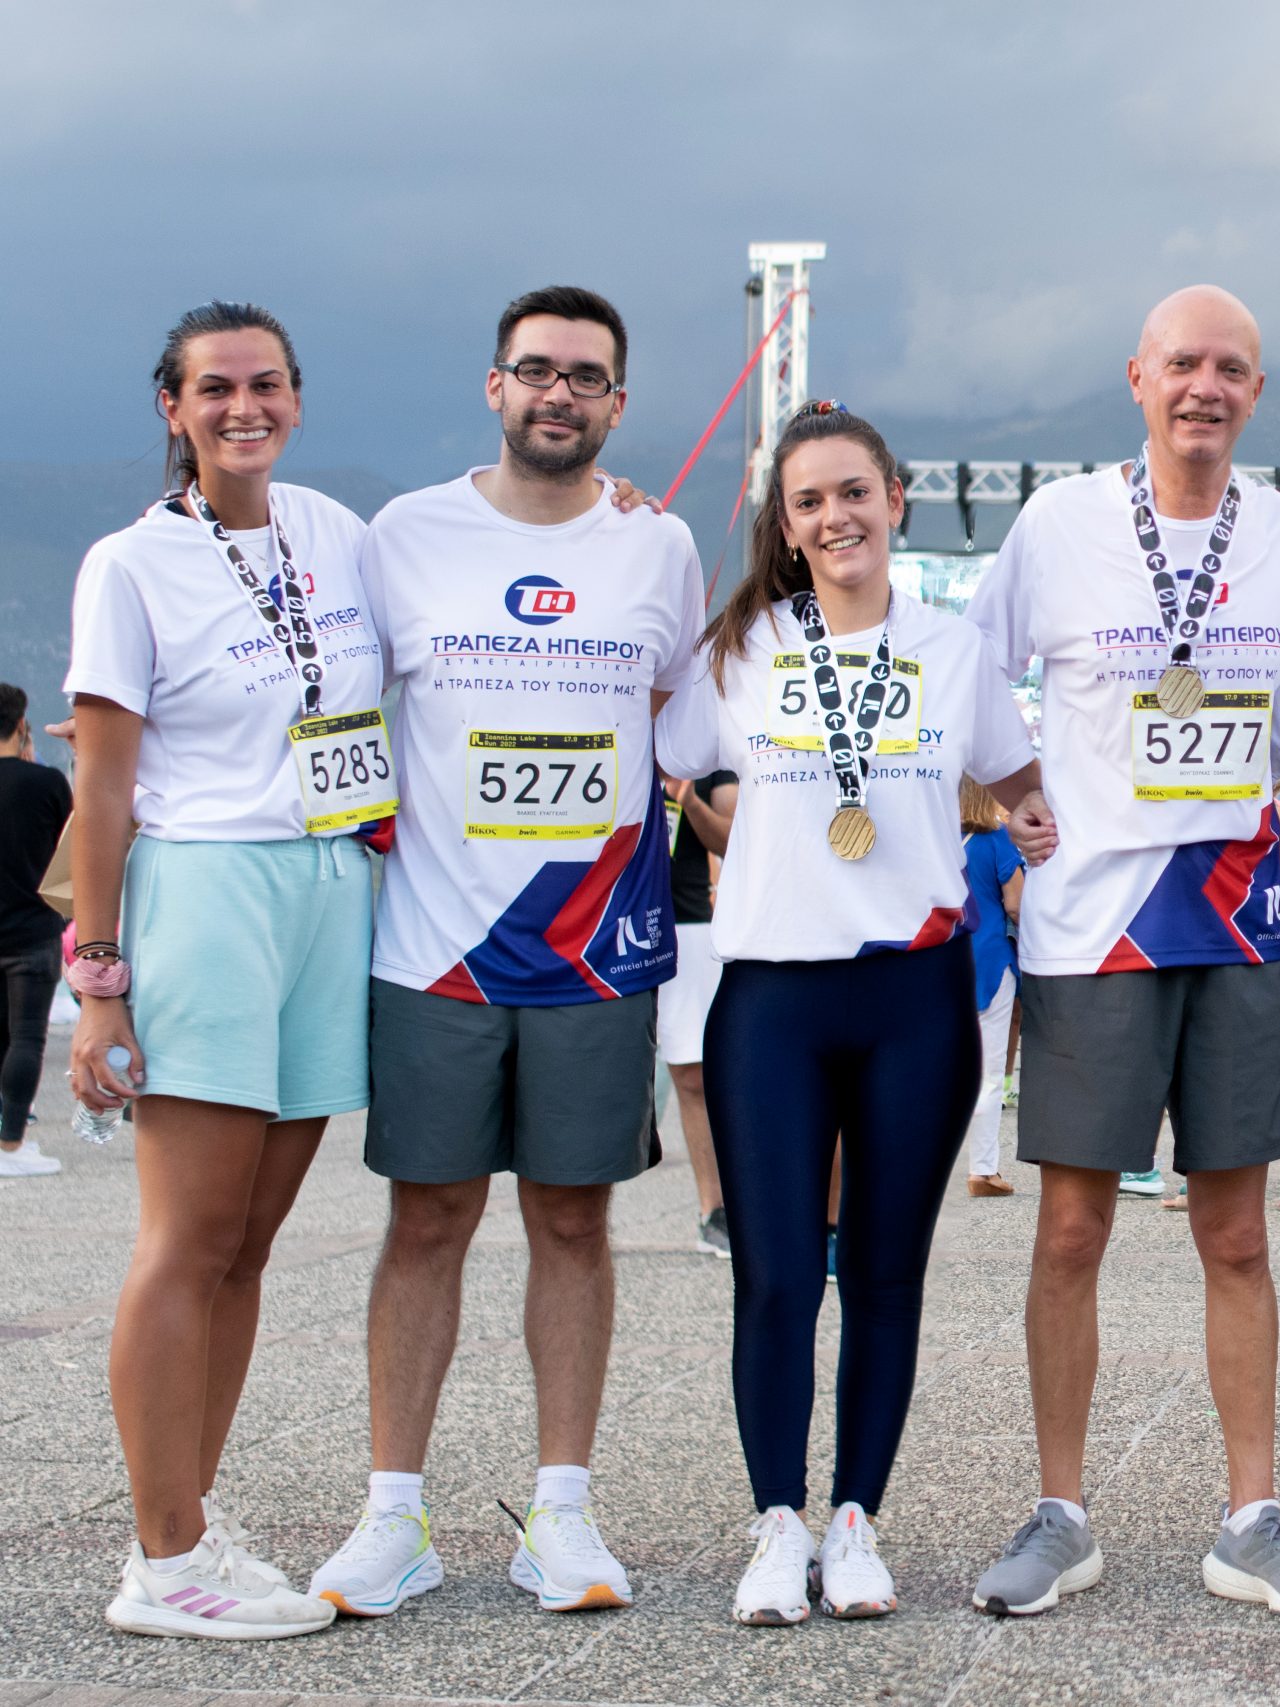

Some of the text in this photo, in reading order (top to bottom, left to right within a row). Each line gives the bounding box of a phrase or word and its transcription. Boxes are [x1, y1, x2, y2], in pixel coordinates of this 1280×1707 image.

[314, 607, 360, 630] ΗΠΕΙΡ
[1092, 627, 1166, 646] ΤΡΑΠΕ
[431, 635, 644, 659] ΤΡΑΠΕΖΑ ΗΠΕΙΡΟΥ
[324, 653, 339, 666] ΟΥ
[1110, 669, 1166, 681] ΤΡΑΠΕΖ
[1218, 669, 1262, 679] ΤΟΠΟΥ
[434, 679, 636, 696] Η ΤΡΑΠΕΖΑ ΤΟΥ ΤΟΠΟΥ ΜΑΣ
[1146, 722, 1263, 764] 5277
[310, 740, 390, 794] 5283
[916, 769, 943, 780] ΜΑΣ
[479, 761, 608, 804] 5276
[760, 772, 817, 784] ΤΡΑΠΕΖΑ
[518, 828, 537, 836] bwin
[610, 962, 643, 975] Official
